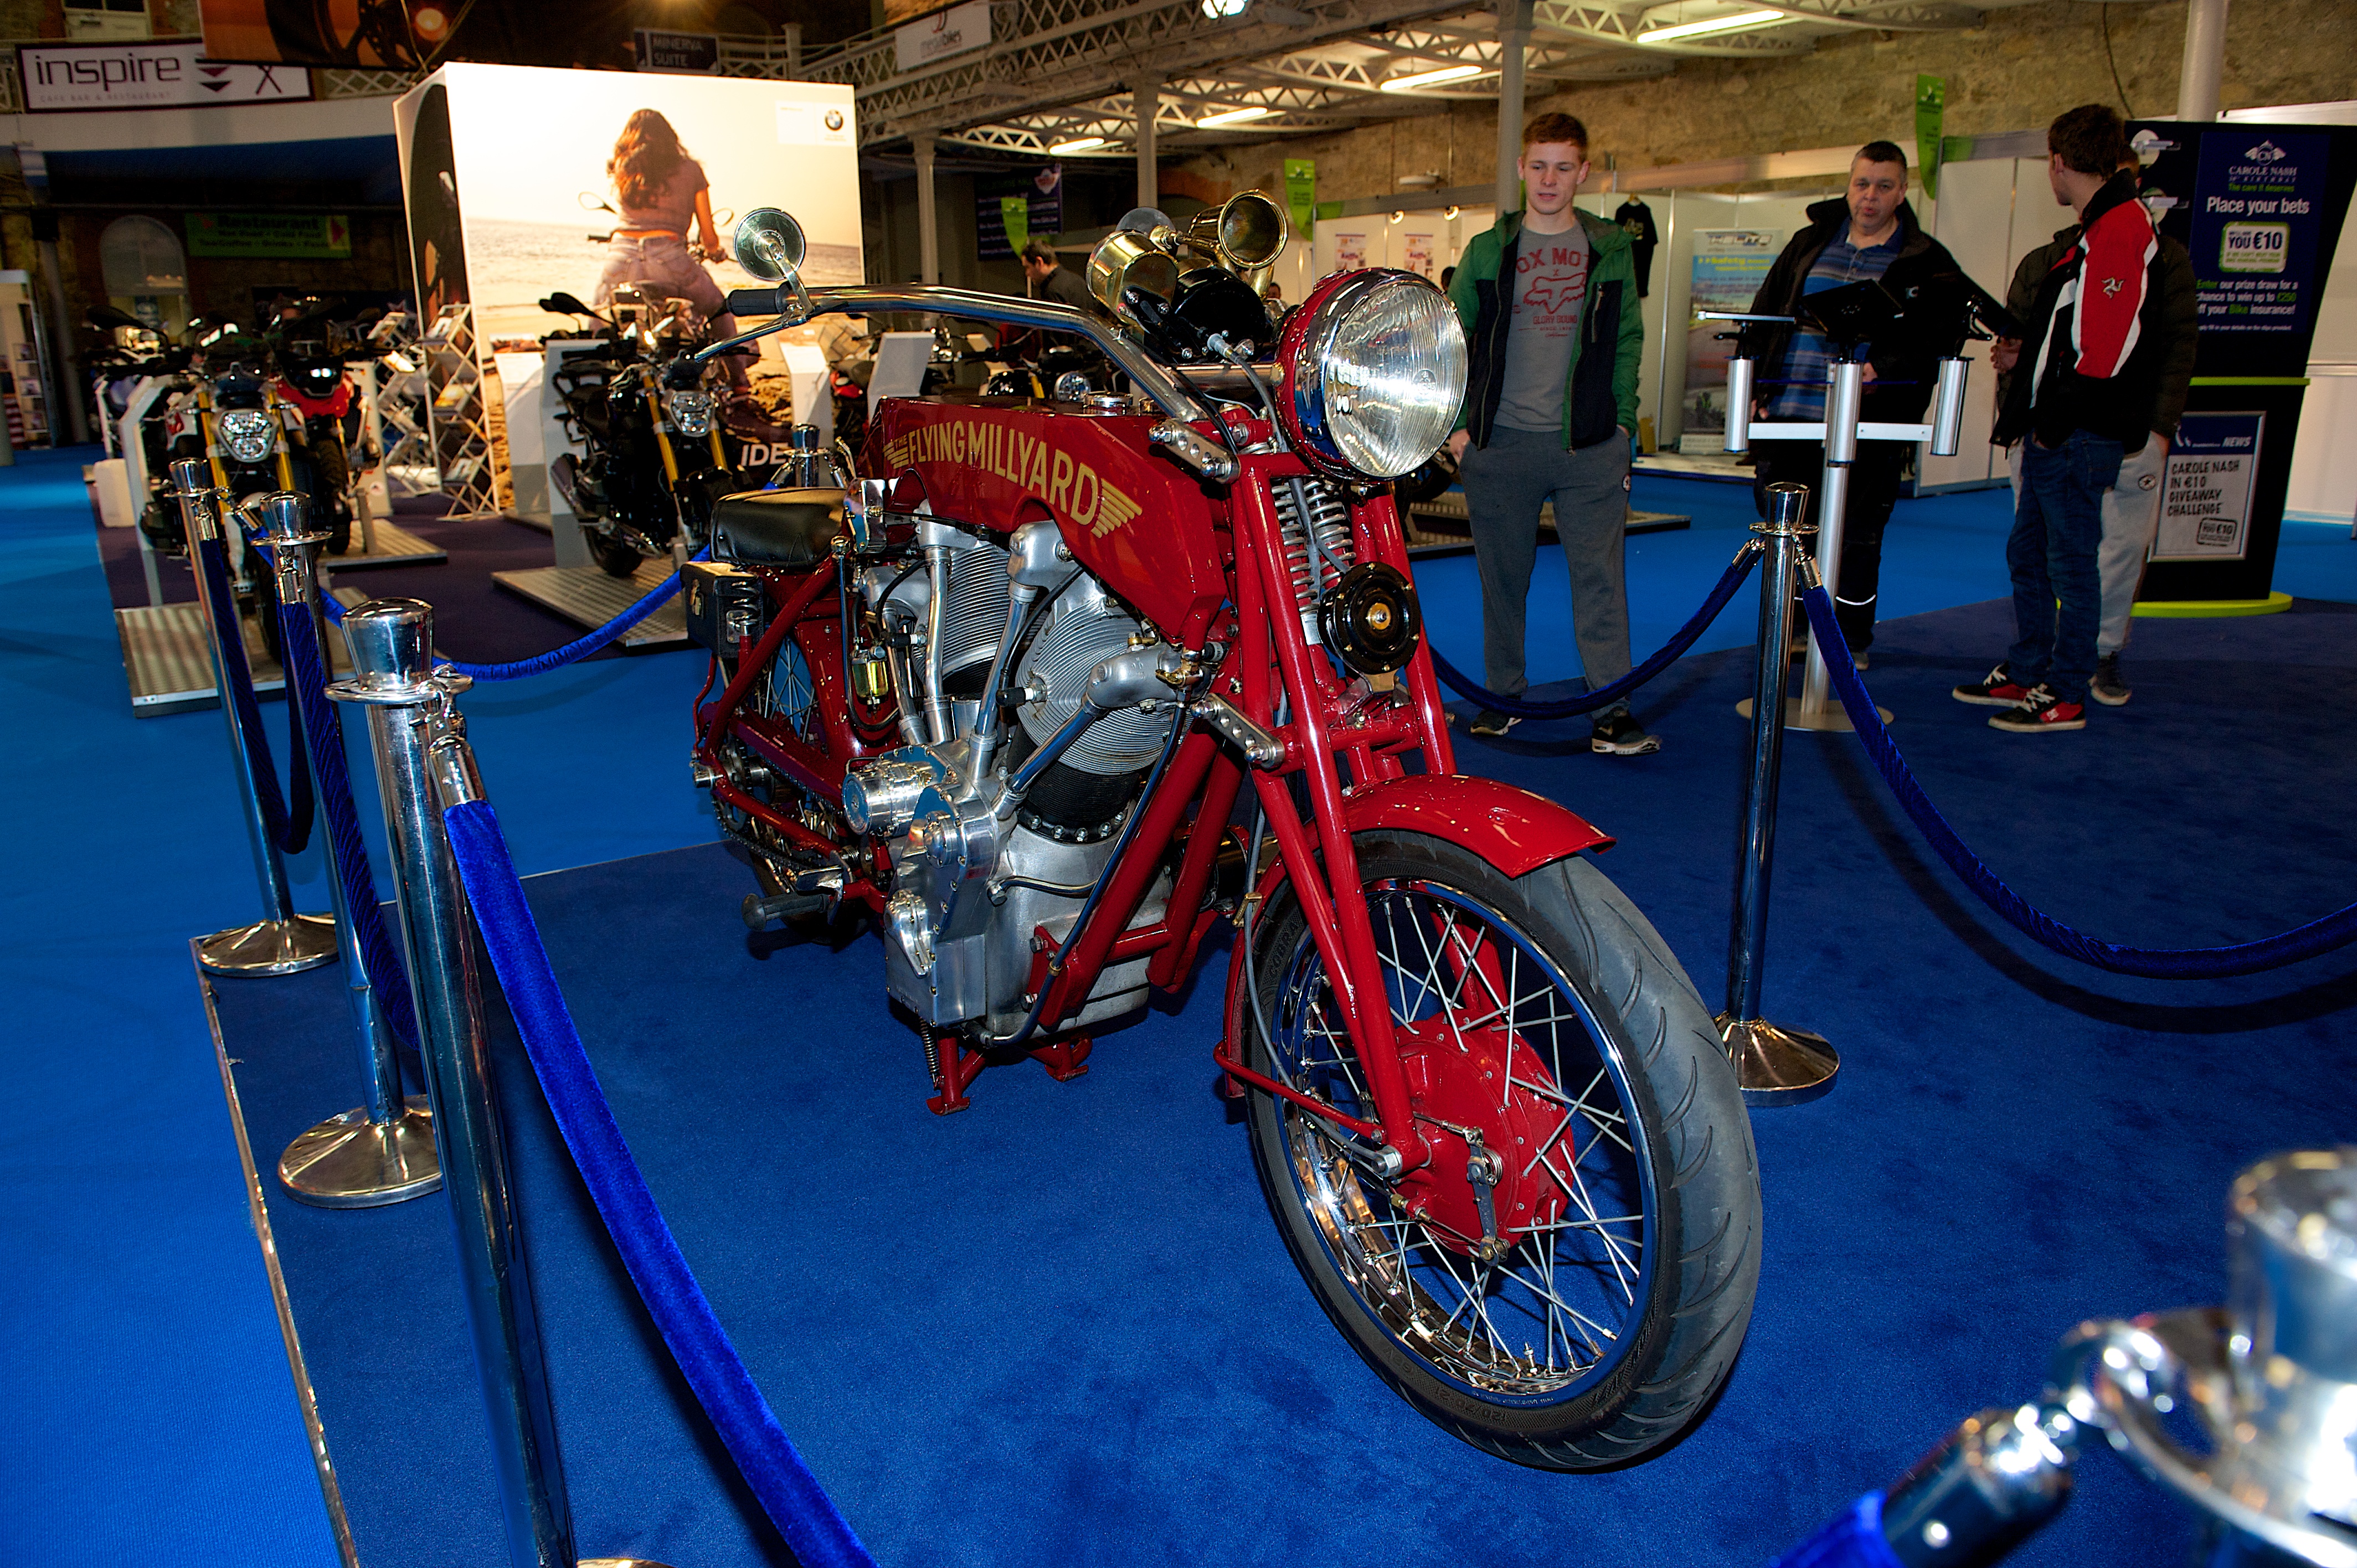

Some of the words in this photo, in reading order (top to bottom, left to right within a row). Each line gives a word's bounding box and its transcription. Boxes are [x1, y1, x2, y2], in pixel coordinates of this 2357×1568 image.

[653, 53, 688, 67] SUITE
[35, 53, 181, 92] inspire
[2228, 166, 2268, 176] CAROLE
[2206, 195, 2245, 213] Place
[2246, 199, 2279, 216] your
[2280, 197, 2310, 215] bets
[218, 215, 318, 230] Restaurant
[2229, 236, 2251, 249] YOU
[2253, 231, 2282, 250] €10
[1516, 248, 1546, 274] OX
[2196, 278, 2219, 290] Enter
[2220, 281, 2235, 290] our
[2235, 279, 2256, 291] prize
[2257, 280, 2279, 290] draw
[2279, 279, 2292, 290] for
[2292, 281, 2298, 290] a
[2227, 292, 2236, 302] to
[2236, 291, 2253, 302] win
[2253, 293, 2266, 304] up
[2266, 292, 2276, 302] to
[2198, 303, 2207, 314] ff
[2207, 306, 2228, 317] your
[2229, 304, 2248, 314] Bike
[2250, 304, 2297, 314] insurance!
[893, 434, 908, 445] THE
[2221, 436, 2252, 447] NEWS
[908, 420, 965, 465] FLYING
[967, 420, 1099, 526] MILLYARD
[2171, 461, 2210, 474] CAROLE
[2212, 460, 2241, 473] NASH
[2170, 477, 2181, 489] IN
[2183, 476, 2207, 488] €10
[2169, 488, 2222, 503] GIVEAWAY
[2167, 502, 2224, 517] CHALLENGE
